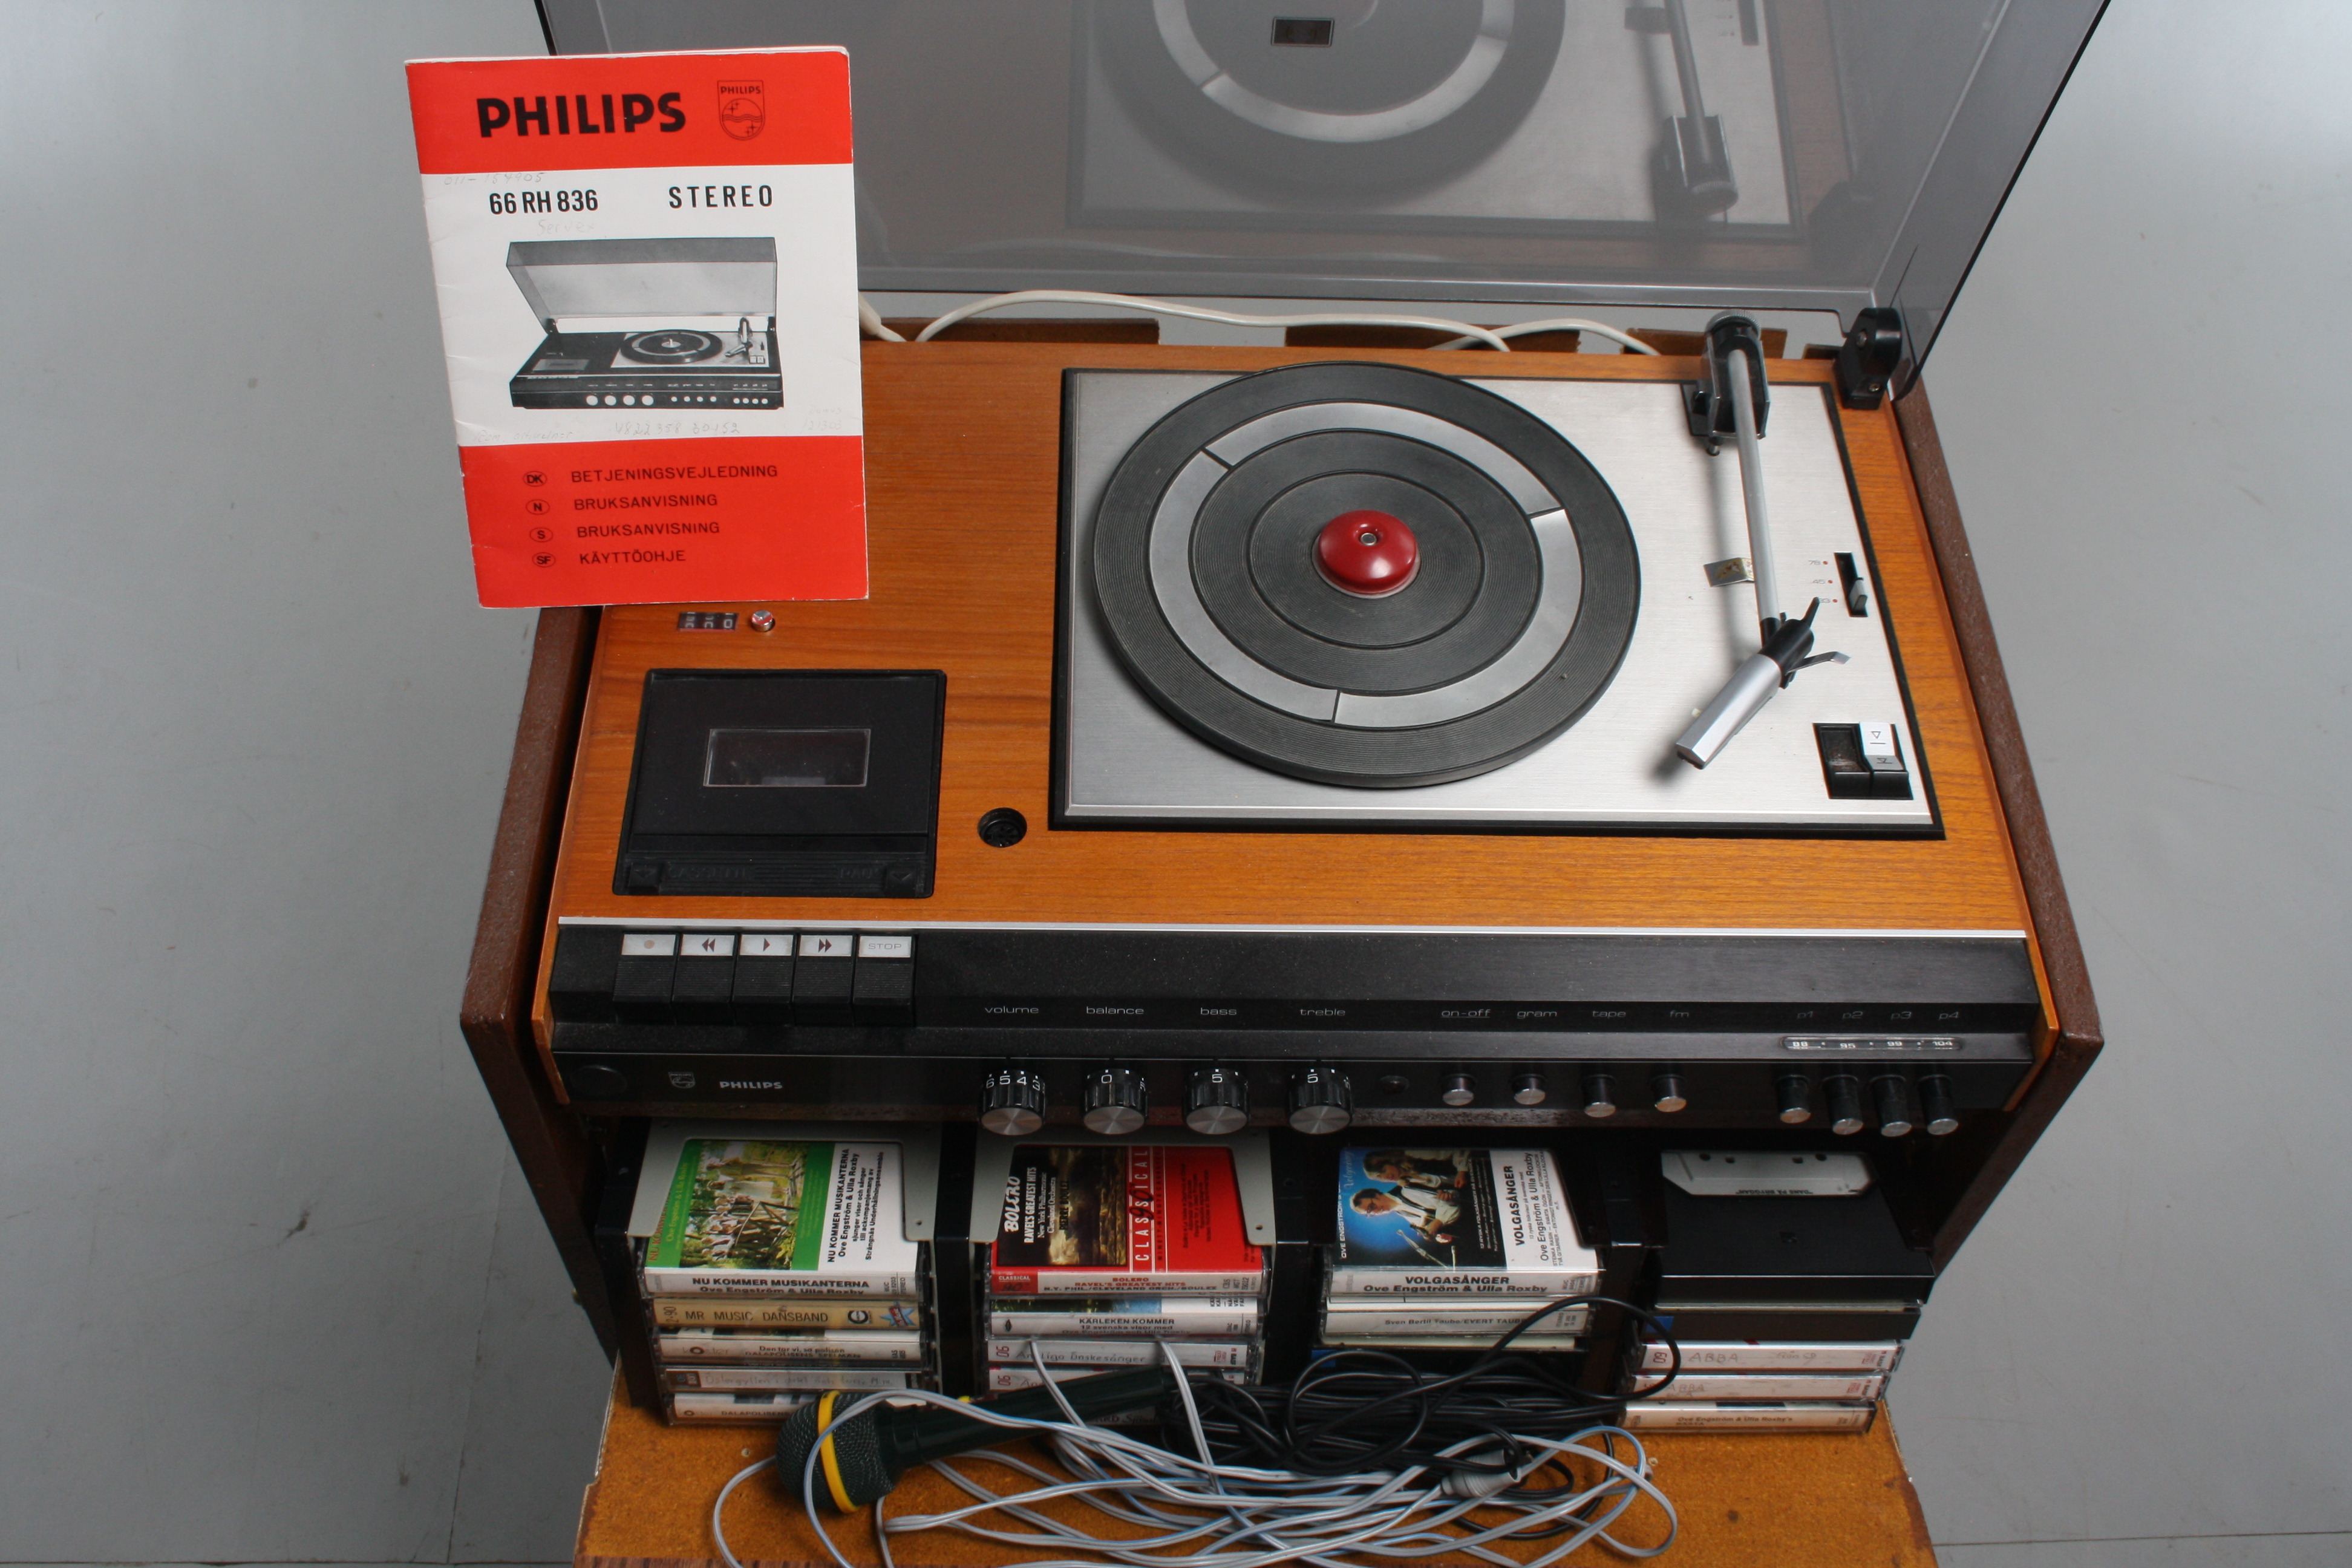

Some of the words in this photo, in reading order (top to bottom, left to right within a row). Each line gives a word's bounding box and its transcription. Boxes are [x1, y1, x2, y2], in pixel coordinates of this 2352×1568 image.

[720, 86, 761, 94] PHILIPS
[477, 92, 686, 138] PHILIPS
[668, 184, 773, 209] STEREO
[527, 473, 544, 485] DK
[571, 465, 779, 483] BETJENINGSVEJLEDNING
[533, 501, 543, 512] N
[573, 494, 718, 511] BRUKSANVISNING
[537, 530, 546, 540] S
[577, 521, 720, 538] BRUKSANVISNING
[536, 555, 551, 565] SF
[580, 549, 686, 564] KÄYTTÖOHJE
[985, 1005, 1039, 1014] volume
[1086, 1005, 1145, 1015] balance
[1200, 1007, 1237, 1016] bass
[1299, 1007, 1346, 1017] treble
[1442, 1008, 1491, 1018] on-off
[1517, 1010, 1557, 1019] gram
[1592, 1009, 1626, 1019] tape
[1670, 1010, 1689, 1019] fm
[1796, 1011, 1814, 1020] p1
[1842, 1011, 1863, 1020] p2
[1890, 1011, 1912, 1020] p3
[1939, 1011, 1960, 1020] p4
[985, 1078, 995, 1089] 6
[999, 1075, 1011, 1085] 5
[1016, 1076, 1027, 1086] 4
[1032, 1079, 1040, 1091] 3
[1101, 1074, 1112, 1083] 0
[1212, 1074, 1223, 1083] 5
[1307, 1074, 1318, 1083] 5
[849, 1153, 860, 1176] Roxby
[1524, 1152, 1535, 1177] Roxby
[833, 1149, 849, 1210] MUSIKANTERNA
[1027, 1167, 1036, 1182] HITS
[846, 1178, 855, 1192] Ulla
[869, 1152, 884, 1226] Underhållningsensemble
[1047, 1177, 1056, 1204] Orchestra
[1528, 1178, 1537, 1194] Ulla
[851, 1218, 861, 1242] sjunger
[857, 1168, 867, 1188] sånger
[861, 1177, 875, 1232] ackompanjemang
[1004, 1176, 1021, 1232] BOLERO
[1025, 1183, 1036, 1215] GREATEST
[1134, 1151, 1149, 1262] CLASSICAL
[1503, 1166, 1525, 1246] VOLGASÅNGER
[840, 1203, 853, 1240] Engström
[1047, 1206, 1055, 1233] Cleveland
[1059, 1207, 1069, 1230] PIERRE
[1532, 1203, 1546, 1243] Engström
[829, 1212, 841, 1248] KOMMER
[1024, 1216, 1034, 1244] RAVEL'S
[1037, 1224, 1045, 1238] New
[838, 1242, 848, 1258] Ove
[865, 1227, 876, 1260] Strängnäs
[827, 1250, 835, 1263] NU
[1540, 1245, 1550, 1262] Ove
[692, 1277, 710, 1285] NU
[713, 1278, 768, 1287] KOMMER
[771, 1278, 870, 1288] MUSIKANTERNA
[1393, 1284, 1459, 1293] Engström
[1506, 1285, 1548, 1293] Roxby
[1405, 1275, 1509, 1284] VOLGASÅNGER
[685, 1310, 704, 1320] MR
[713, 1311, 753, 1322] MUSIC
[762, 1311, 828, 1322] DANSBAND
[995, 1345, 1010, 1358] 90
[1653, 1351, 1667, 1364] 60
[1688, 1352, 1738, 1363] ABBA
[997, 1374, 1011, 1386] 90
